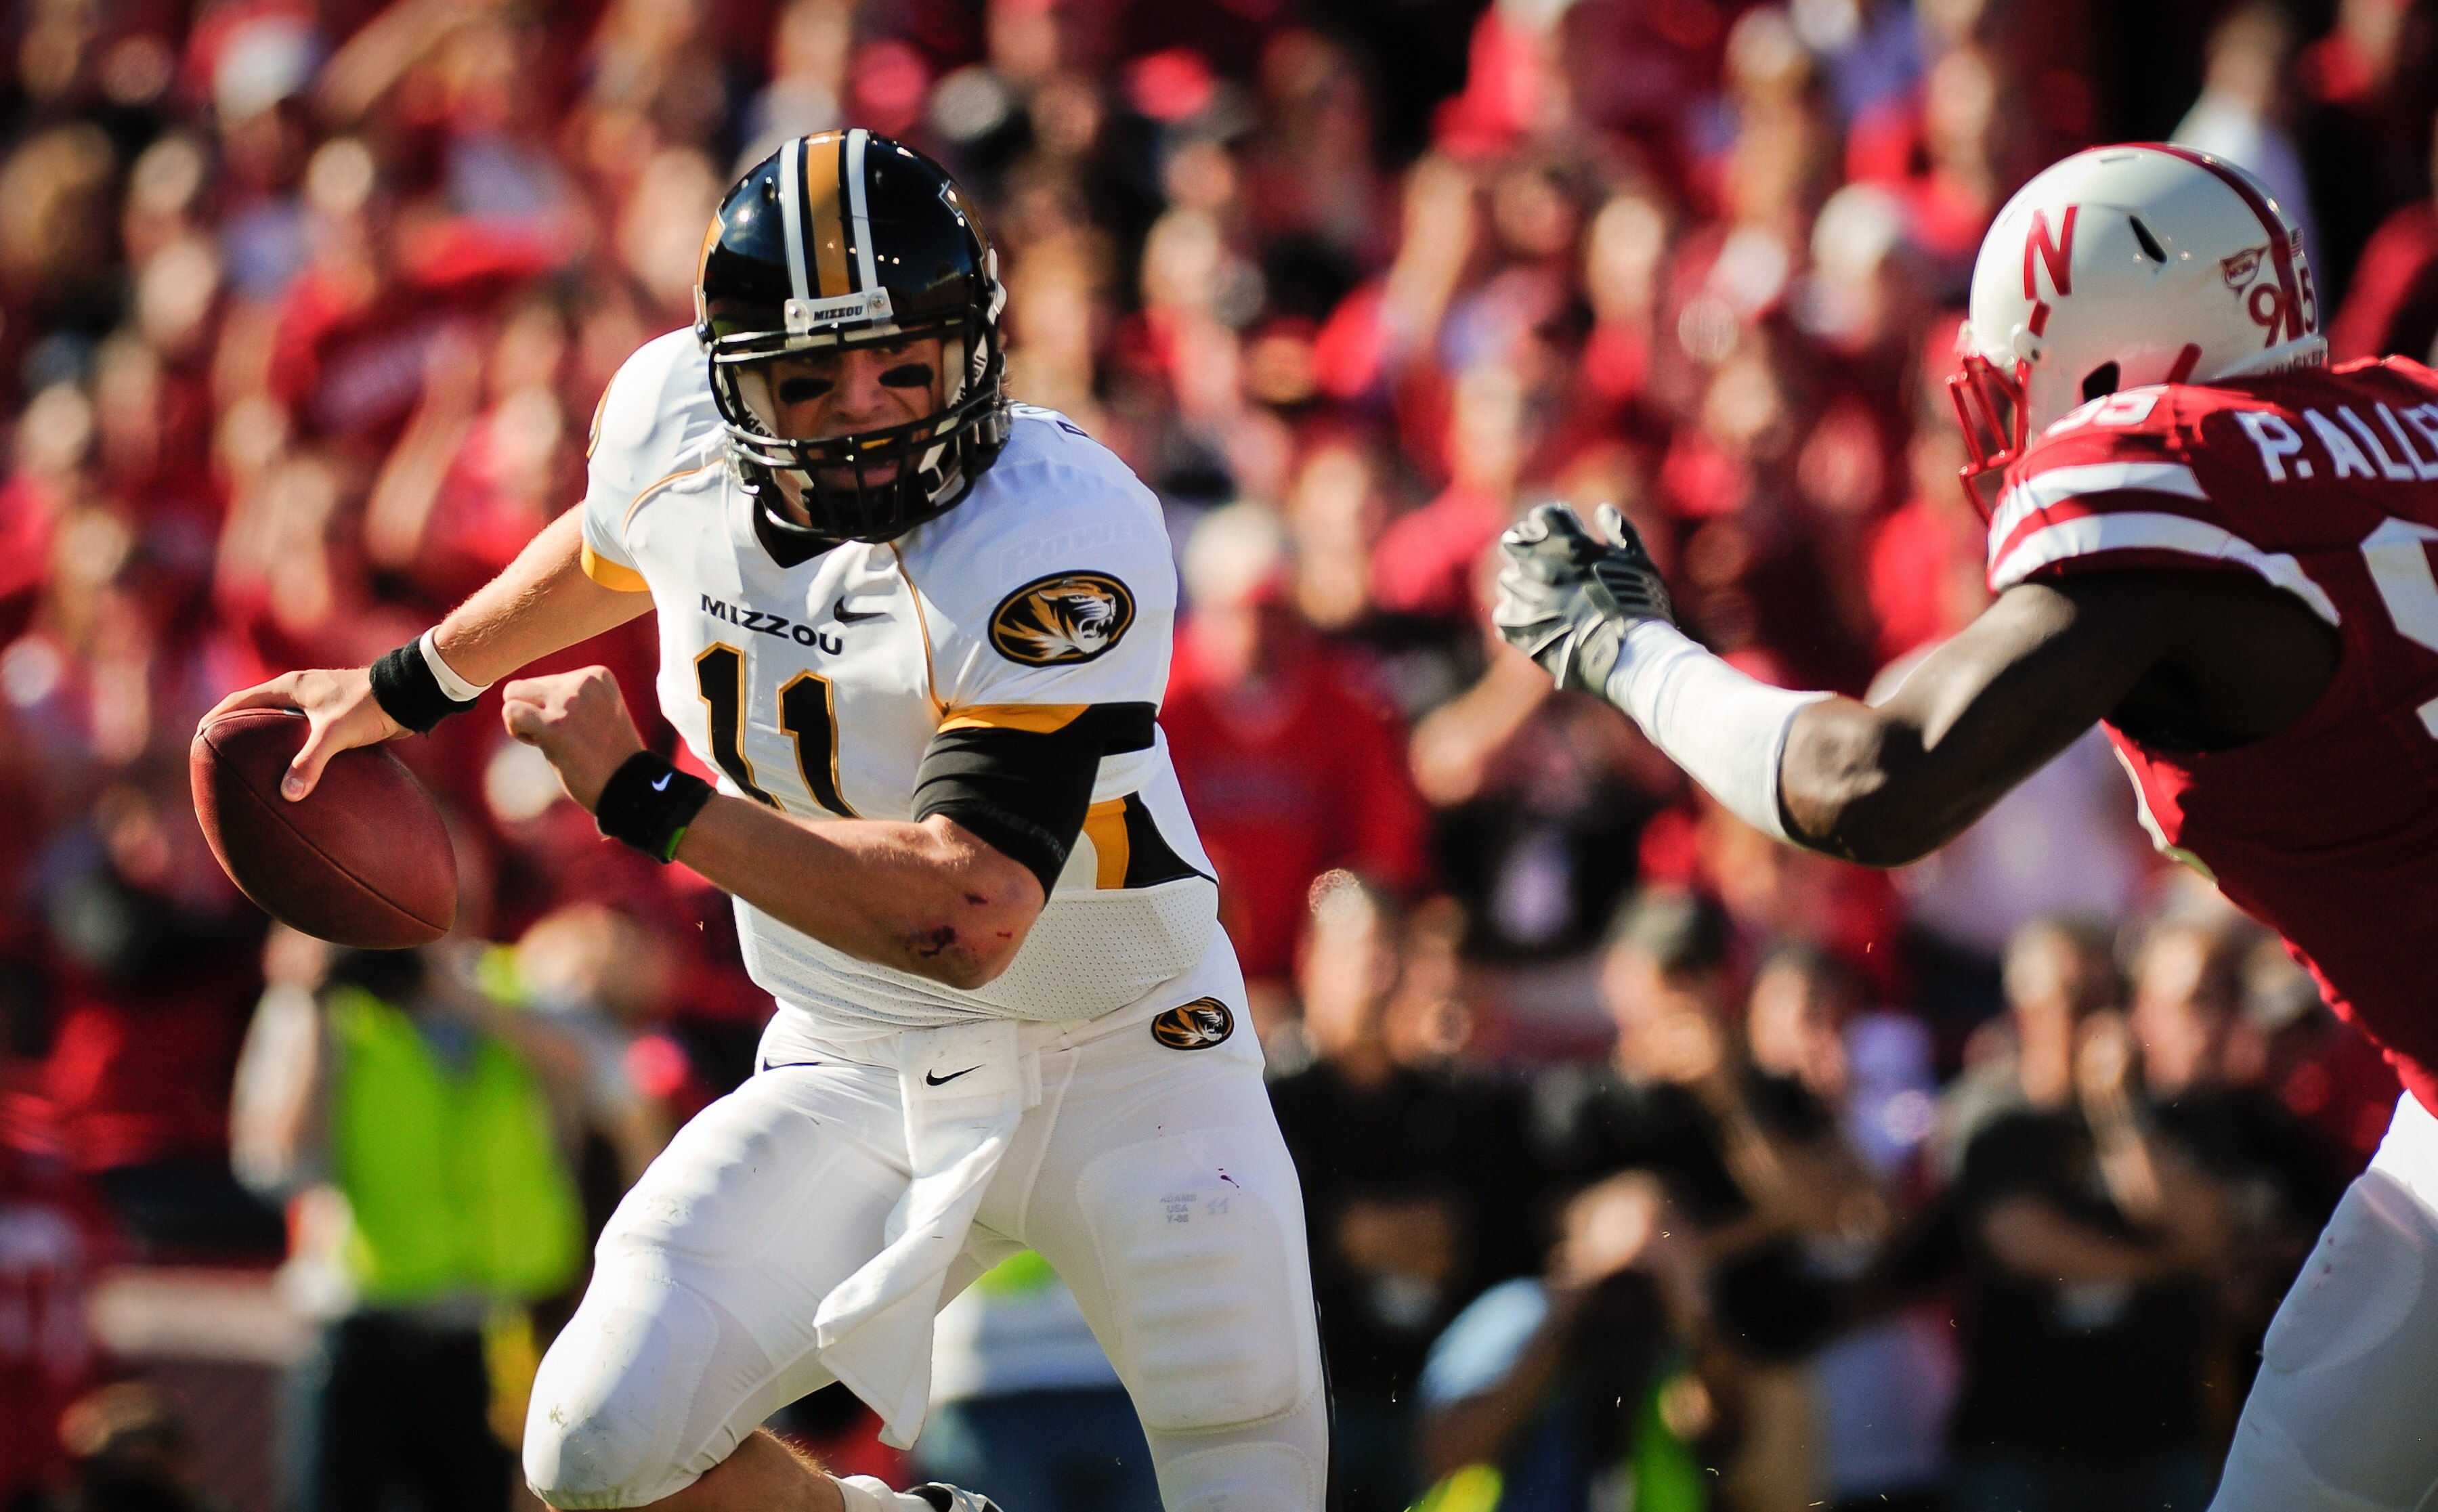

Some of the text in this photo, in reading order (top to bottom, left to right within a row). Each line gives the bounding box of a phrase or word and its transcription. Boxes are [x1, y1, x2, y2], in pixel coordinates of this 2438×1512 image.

[2023, 205, 2076, 301] N
[814, 305, 863, 322] MIZZOU
[2303, 402, 2438, 481] ALLE
[701, 593, 843, 655] MIZZOU
[693, 641, 864, 821] 11
